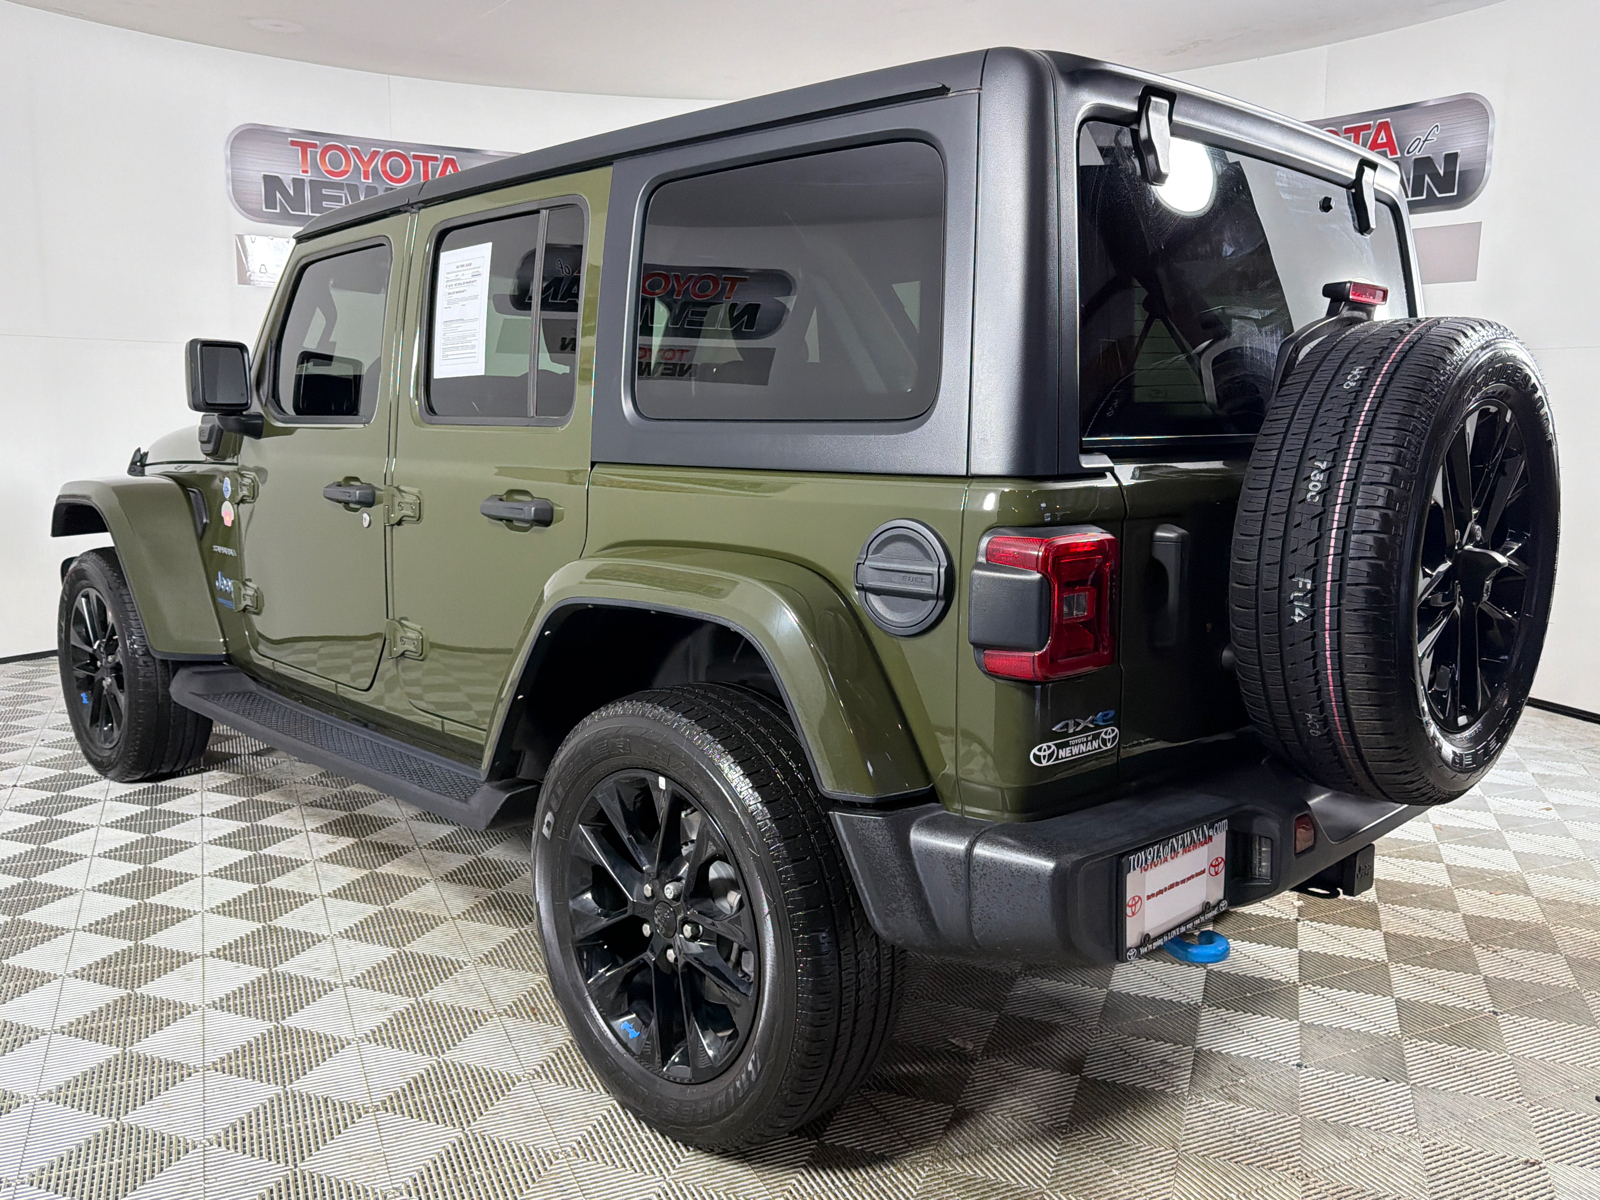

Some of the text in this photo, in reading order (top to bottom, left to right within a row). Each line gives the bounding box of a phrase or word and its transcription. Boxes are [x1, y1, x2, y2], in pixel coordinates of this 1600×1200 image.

[1405, 123, 1440, 156] of
[288, 138, 460, 185] TOYOTA
[901, 575, 927, 584] FUEL
[1058, 740, 1099, 759] NEWNAN
[1068, 736, 1087, 746] TOYOTA
